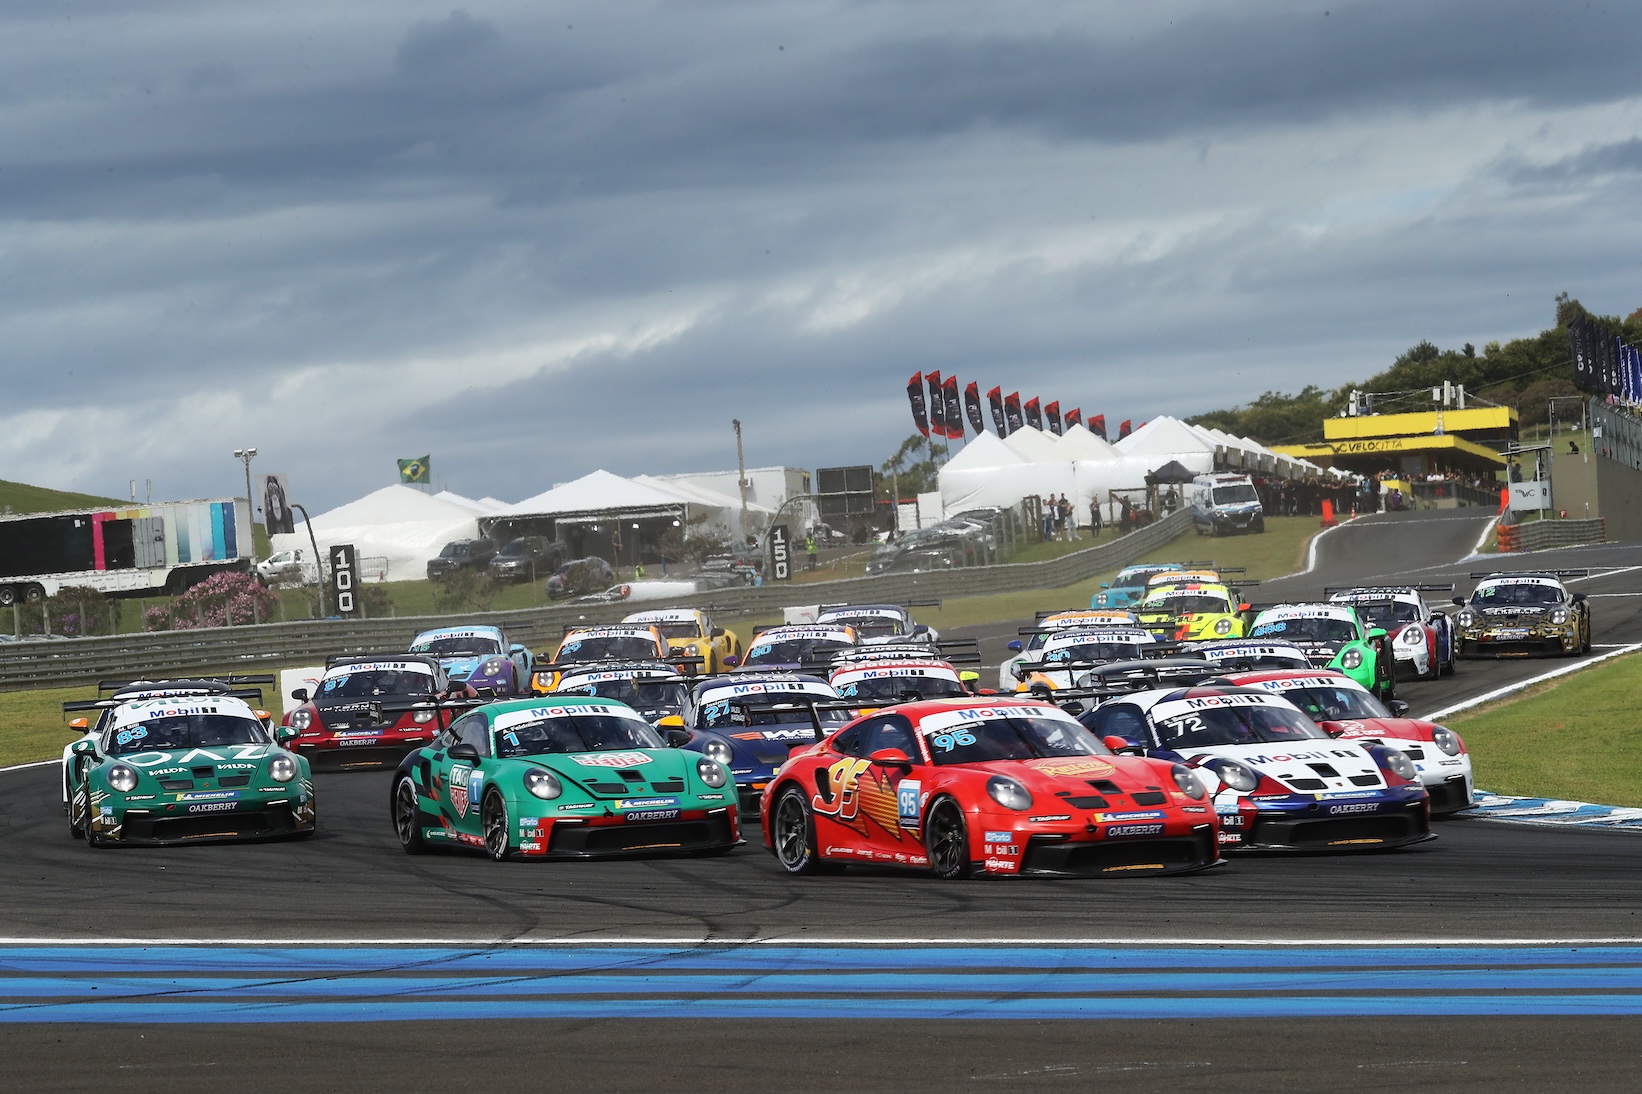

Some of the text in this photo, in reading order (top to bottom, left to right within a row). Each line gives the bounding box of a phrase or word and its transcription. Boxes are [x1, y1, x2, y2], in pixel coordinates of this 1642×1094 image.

[774, 528, 787, 578] 150
[336, 549, 353, 611] 100
[1278, 611, 1315, 619] Mobil
[1254, 622, 1286, 637] 888
[1073, 635, 1114, 643] Mobil
[1210, 648, 1257, 658] Mobil
[350, 662, 390, 671] Mobil
[588, 671, 634, 681] Mobil
[864, 669, 909, 678] Mobil
[324, 677, 349, 691] 87
[733, 683, 786, 694] Mobil
[1262, 678, 1316, 690] Mobil
[1185, 695, 1246, 710] Mobil
[150, 707, 200, 718] Mobil
[530, 706, 589, 718] Mobil
[704, 702, 731, 721] 27
[957, 707, 1021, 721] Mobil
[1167, 717, 1208, 737] 72
[117, 726, 148, 745] 83
[503, 732, 520, 746] 1
[933, 729, 977, 753] 95
[339, 738, 378, 747] OAKBERRY
[1243, 751, 1330, 766] Mobil
[452, 767, 468, 787] TAG
[472, 781, 478, 801] 1
[811, 757, 872, 819] 95
[188, 802, 238, 813] OAKBERRY
[633, 798, 675, 806] MICHELIN
[901, 791, 917, 816] 95
[1330, 802, 1380, 815] OAKBERRY
[627, 809, 678, 821] OAKBERRY
[1108, 824, 1163, 837] OAKBERRY
[984, 844, 1008, 855] Mbil
